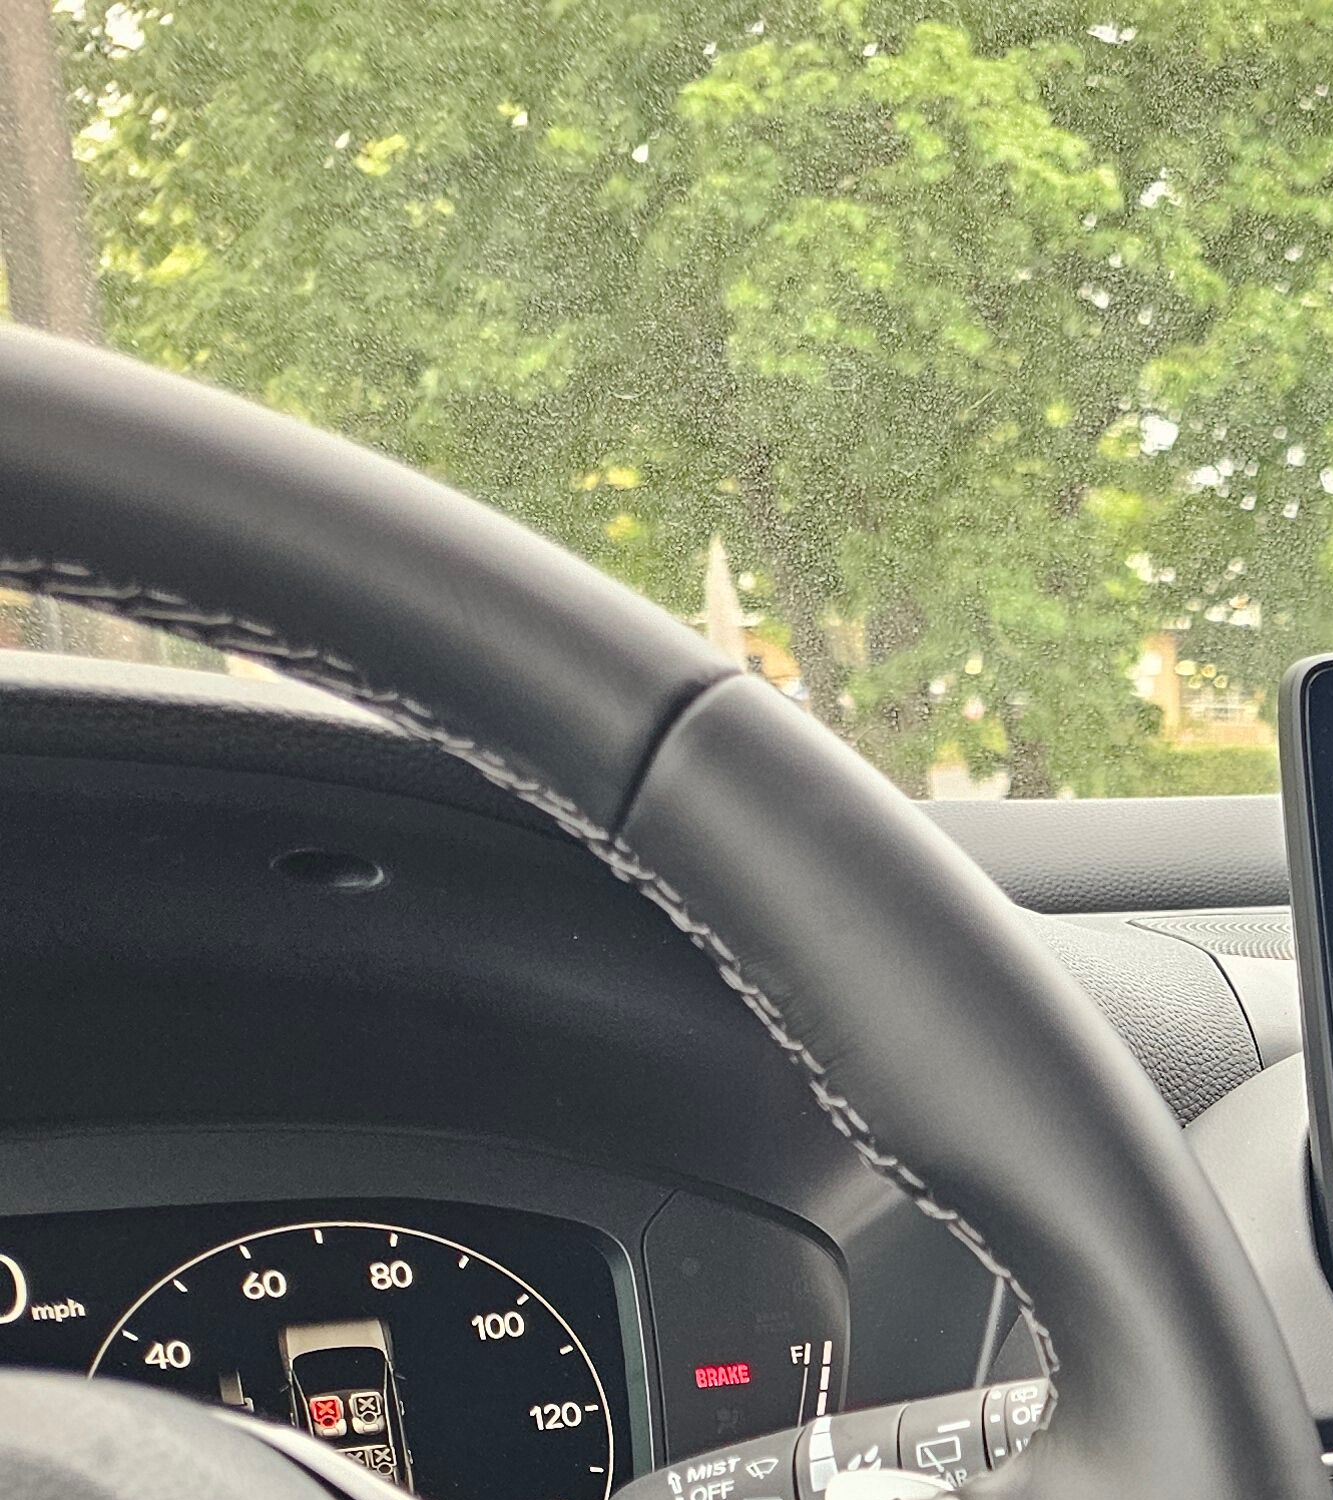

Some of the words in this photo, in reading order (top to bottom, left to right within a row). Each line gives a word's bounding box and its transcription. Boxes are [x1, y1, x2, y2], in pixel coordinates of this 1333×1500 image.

[243, 1270, 287, 1299] 60
[369, 1261, 413, 1290] 80
[32, 1299, 86, 1322] mph
[472, 1311, 525, 1340] 100
[145, 1340, 191, 1369] 40
[790, 1345, 803, 1365] F
[695, 1363, 751, 1388] BRAKE
[530, 1402, 582, 1430] 120
[1012, 1404, 1043, 1425] OF
[687, 1455, 741, 1483] MIST
